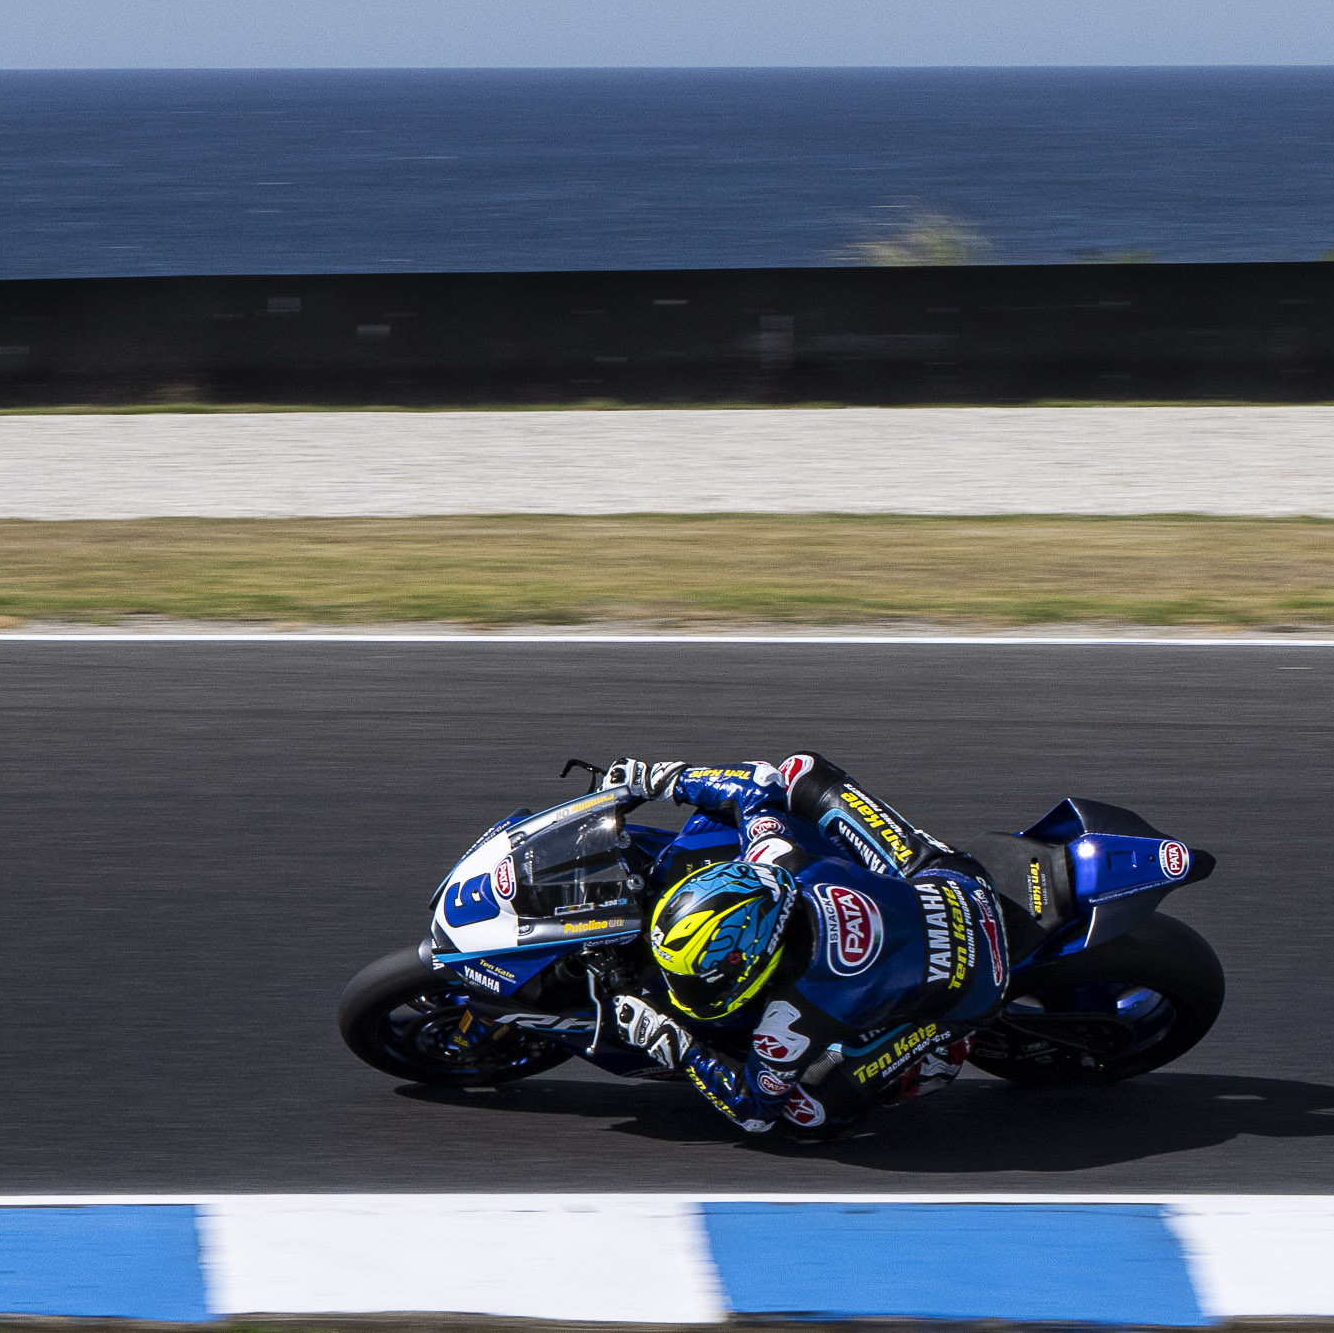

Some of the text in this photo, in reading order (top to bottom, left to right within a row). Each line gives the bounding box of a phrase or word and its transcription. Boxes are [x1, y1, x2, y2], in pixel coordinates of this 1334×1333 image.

[840, 792, 880, 829] Kate
[881, 828, 913, 863] Ten
[1170, 846, 1180, 872] PATA
[496, 864, 510, 892] PATA
[1030, 862, 1043, 914] Ten Kate
[444, 873, 501, 928] 9
[767, 888, 797, 956] SHARK
[828, 897, 839, 944] SNACK
[563, 919, 608, 934] Putoline
[844, 892, 865, 954] PATA
[914, 883, 952, 983] YAMAHA
[942, 886, 968, 990] Ten Kate
[966, 925, 975, 968] RACING
[464, 965, 501, 993] YAMAHA
[479, 958, 495, 971] Ten
[494, 966, 516, 979] Kate
[852, 1053, 893, 1084] Ten
[893, 1022, 938, 1057] Kate
[881, 1052, 911, 1078] RACING
